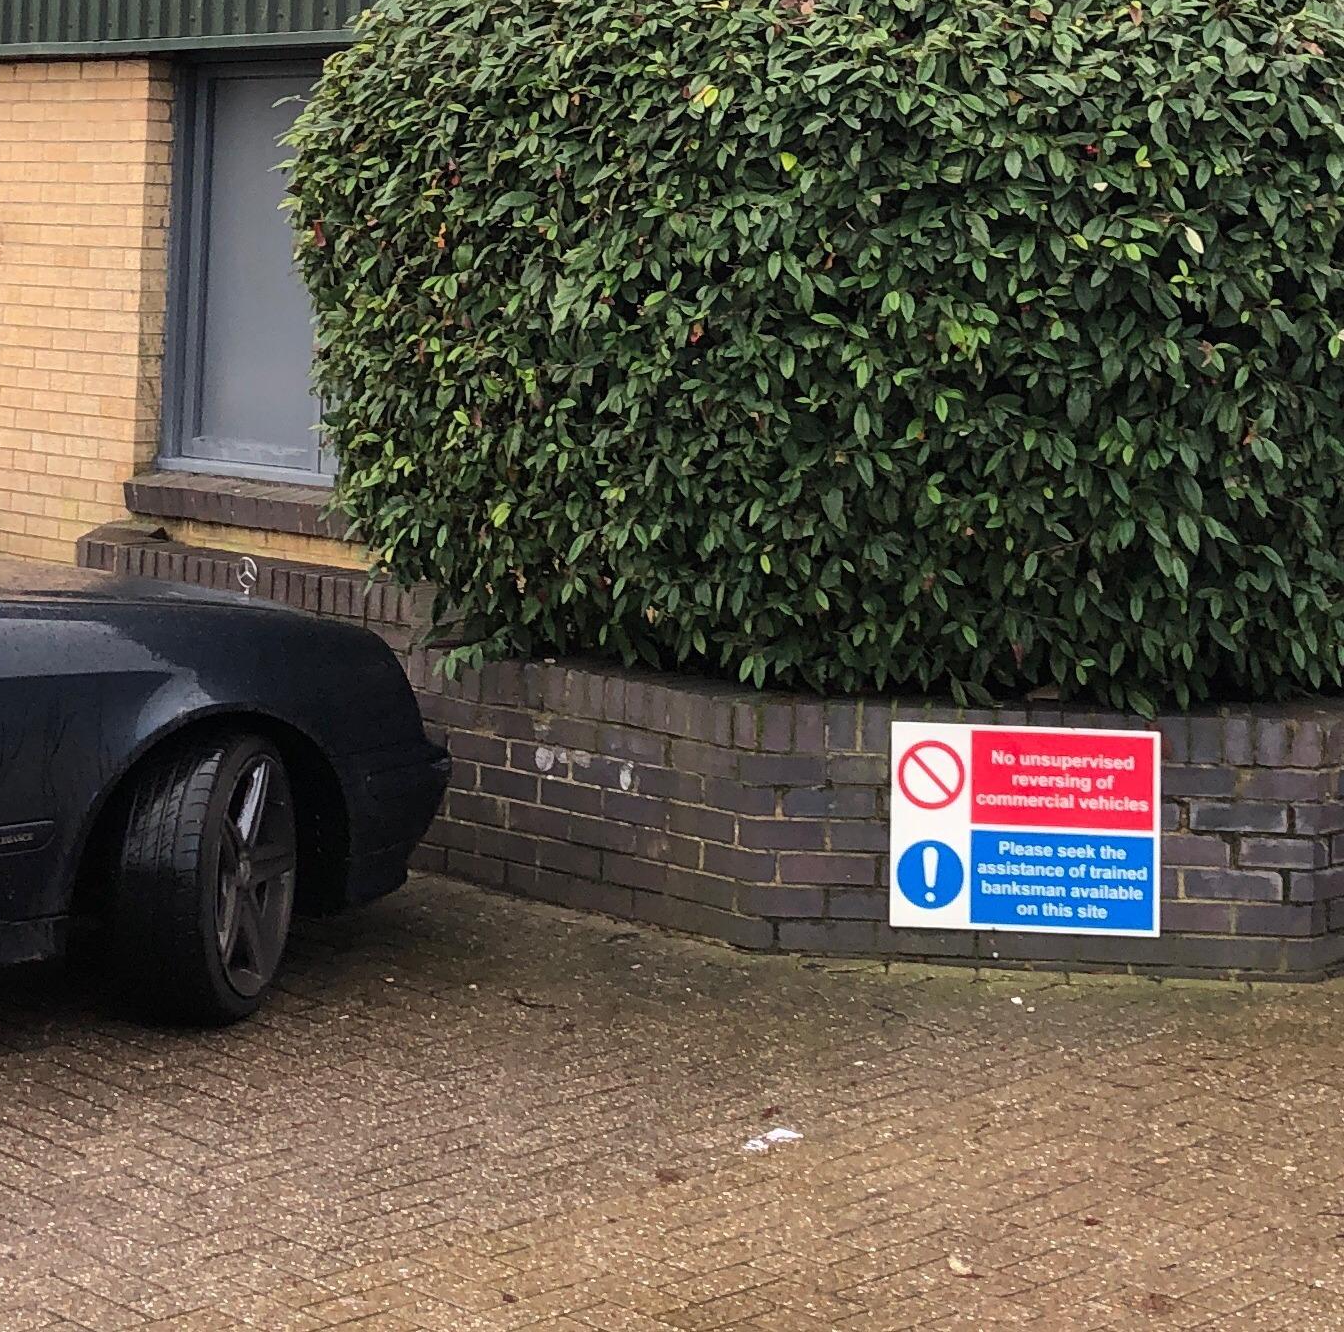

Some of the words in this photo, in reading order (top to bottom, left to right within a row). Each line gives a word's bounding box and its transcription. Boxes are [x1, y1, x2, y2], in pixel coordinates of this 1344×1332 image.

[991, 749, 1016, 765] No
[1019, 753, 1135, 770] unsupervised
[1011, 773, 1092, 792] reversing
[1095, 774, 1115, 790] of
[976, 793, 1074, 809] commercial
[1078, 795, 1149, 812] vehicles
[998, 840, 1053, 857] Please
[1057, 844, 1096, 859] seek
[1100, 845, 1127, 860] the
[977, 861, 1065, 878] assistance
[1068, 863, 1087, 878] of
[1090, 865, 1148, 881] trained
[981, 880, 1066, 897] banksman
[1070, 884, 1144, 901] available
[1016, 903, 1038, 916] on
[1042, 902, 1073, 918] this
[1077, 904, 1108, 919] site
